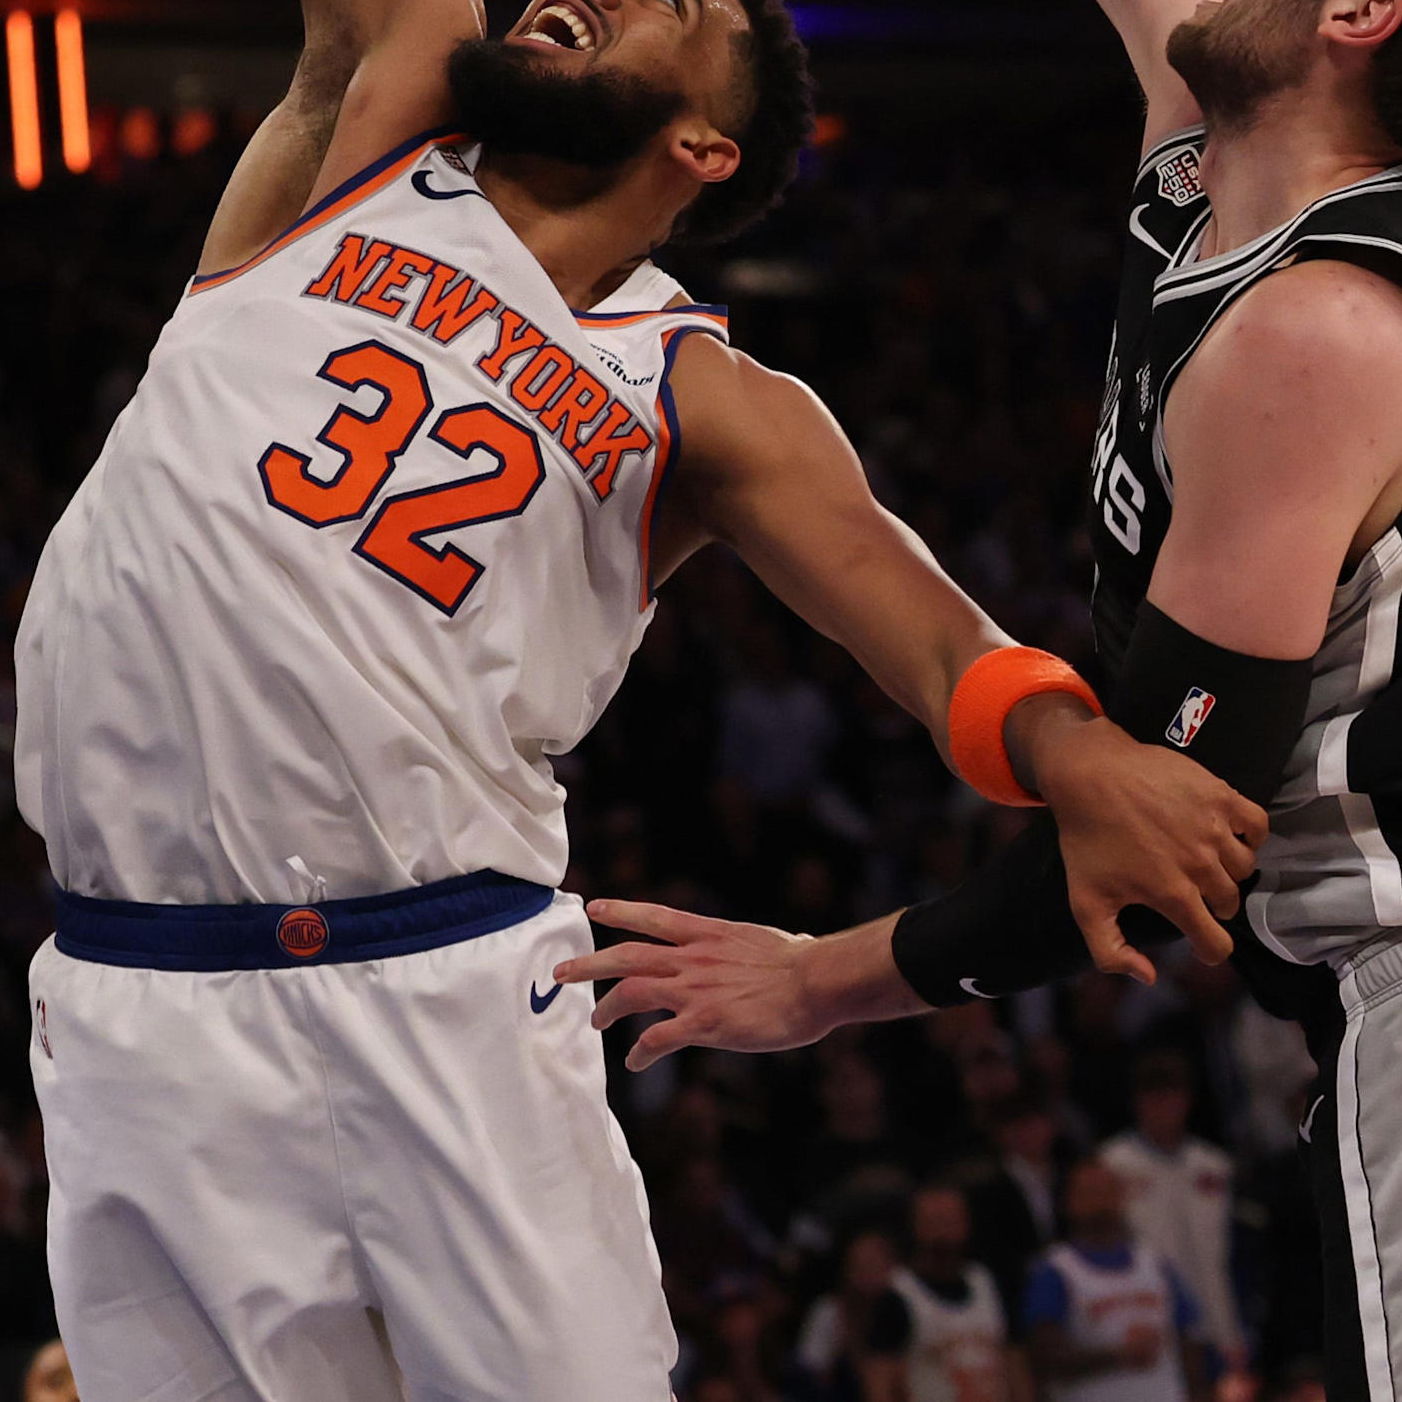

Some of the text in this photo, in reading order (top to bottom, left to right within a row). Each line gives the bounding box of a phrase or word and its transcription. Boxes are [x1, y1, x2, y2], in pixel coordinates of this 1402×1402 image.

[1161, 162, 1189, 202] 250
[258, 339, 546, 617] 32
[302, 233, 656, 507] NEW YORK
